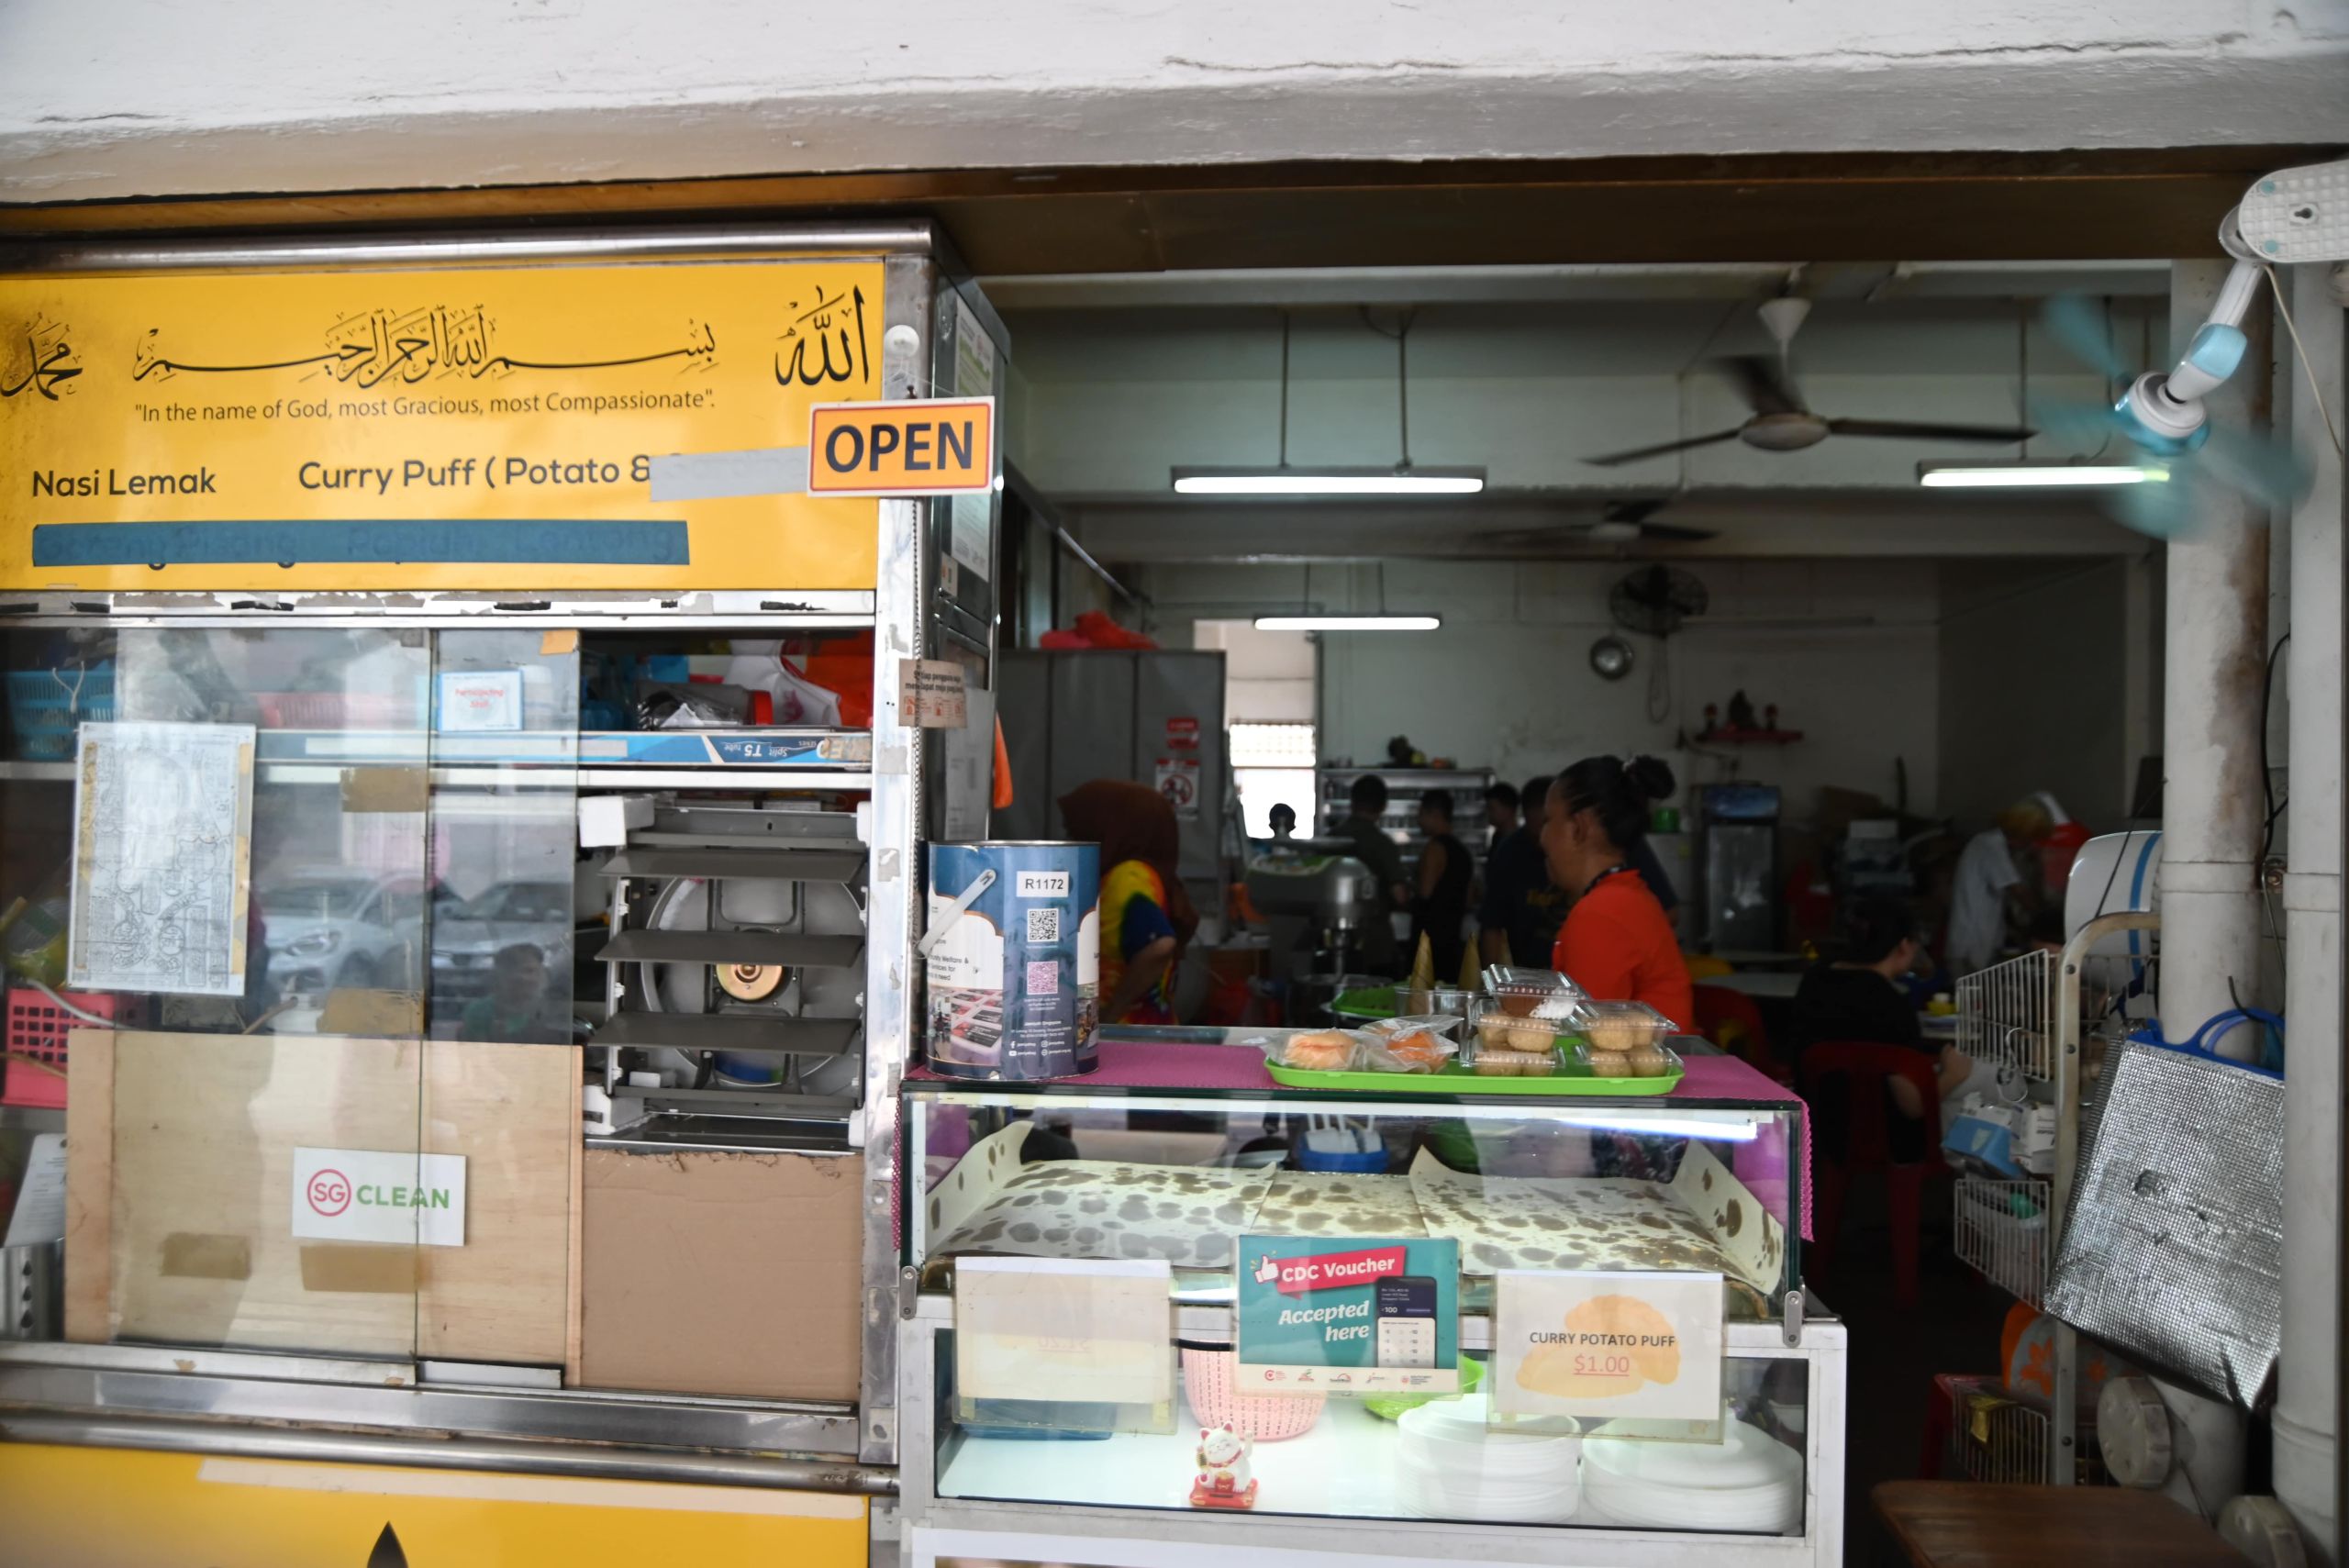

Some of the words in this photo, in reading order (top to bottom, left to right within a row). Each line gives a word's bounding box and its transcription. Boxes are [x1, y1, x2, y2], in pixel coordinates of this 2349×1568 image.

[166, 403, 197, 421] the
[203, 405, 257, 420] name
[263, 400, 282, 419] of
[287, 398, 332, 420] God,
[339, 399, 387, 417] most
[393, 395, 484, 417] Gracious,
[490, 395, 540, 414] most
[825, 421, 974, 473] OPEN
[32, 470, 101, 497] Nasi
[108, 466, 217, 496] Lemak
[298, 461, 394, 495] Curry
[403, 457, 476, 487] Puff
[744, 744, 763, 758] T5
[768, 747, 788, 758] Split
[1025, 878, 1064, 890] R1172
[313, 1182, 346, 1204] SG
[356, 1184, 450, 1209] CLEAN
[1282, 1264, 1319, 1283] CDC
[1324, 1256, 1396, 1278] Voucher
[1277, 1299, 1370, 1326] Accepted
[1324, 1324, 1370, 1343] here
[1529, 1331, 1576, 1345] CURRY
[1580, 1333, 1637, 1347] POTATO
[1641, 1334, 1675, 1348] PUFF
[1573, 1352, 1631, 1374] $1.00
